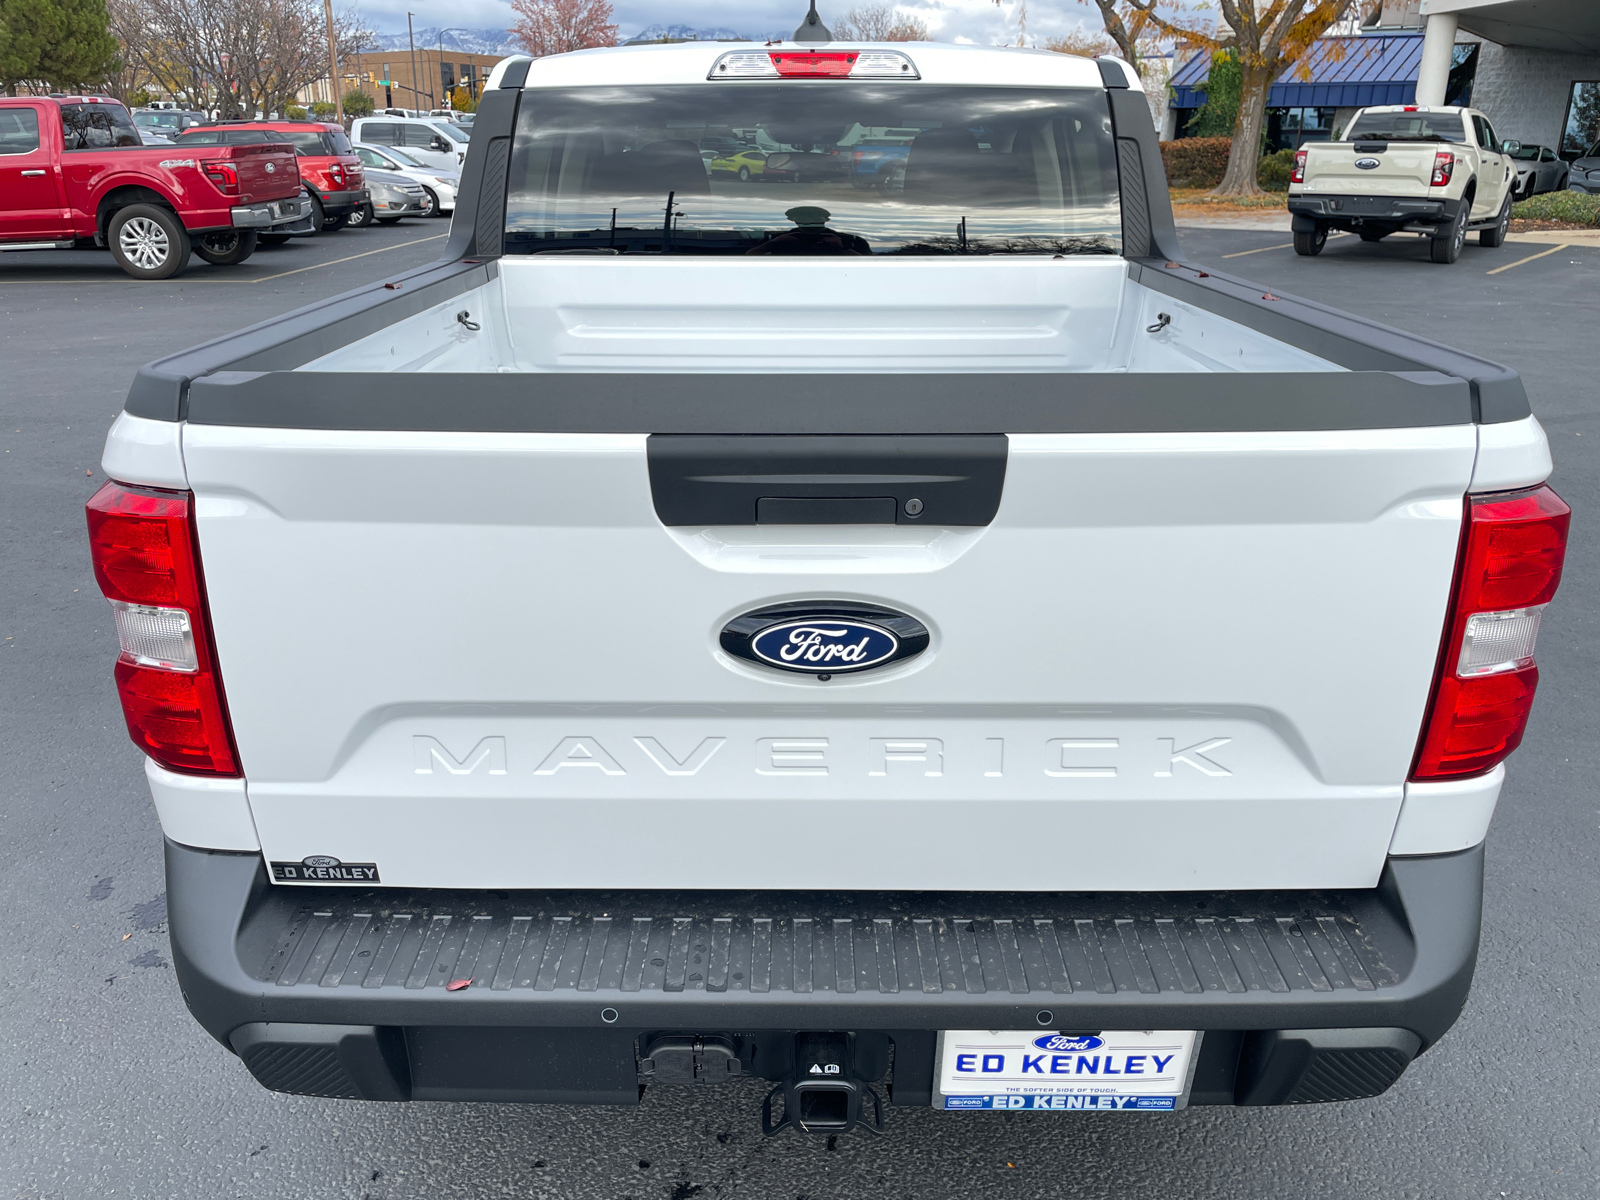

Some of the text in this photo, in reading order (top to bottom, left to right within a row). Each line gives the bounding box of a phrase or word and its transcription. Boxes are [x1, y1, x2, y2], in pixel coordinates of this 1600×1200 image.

[780, 627, 869, 662] Ford
[413, 735, 1234, 777] MAVERICK
[312, 858, 331, 866] Ford
[273, 867, 375, 879] ED KENLEY
[1046, 1035, 1090, 1050] Ford
[956, 1054, 1175, 1074] ED KENLEY
[992, 1096, 1026, 1108] ED
[1033, 1096, 1130, 1108] KENLEY
